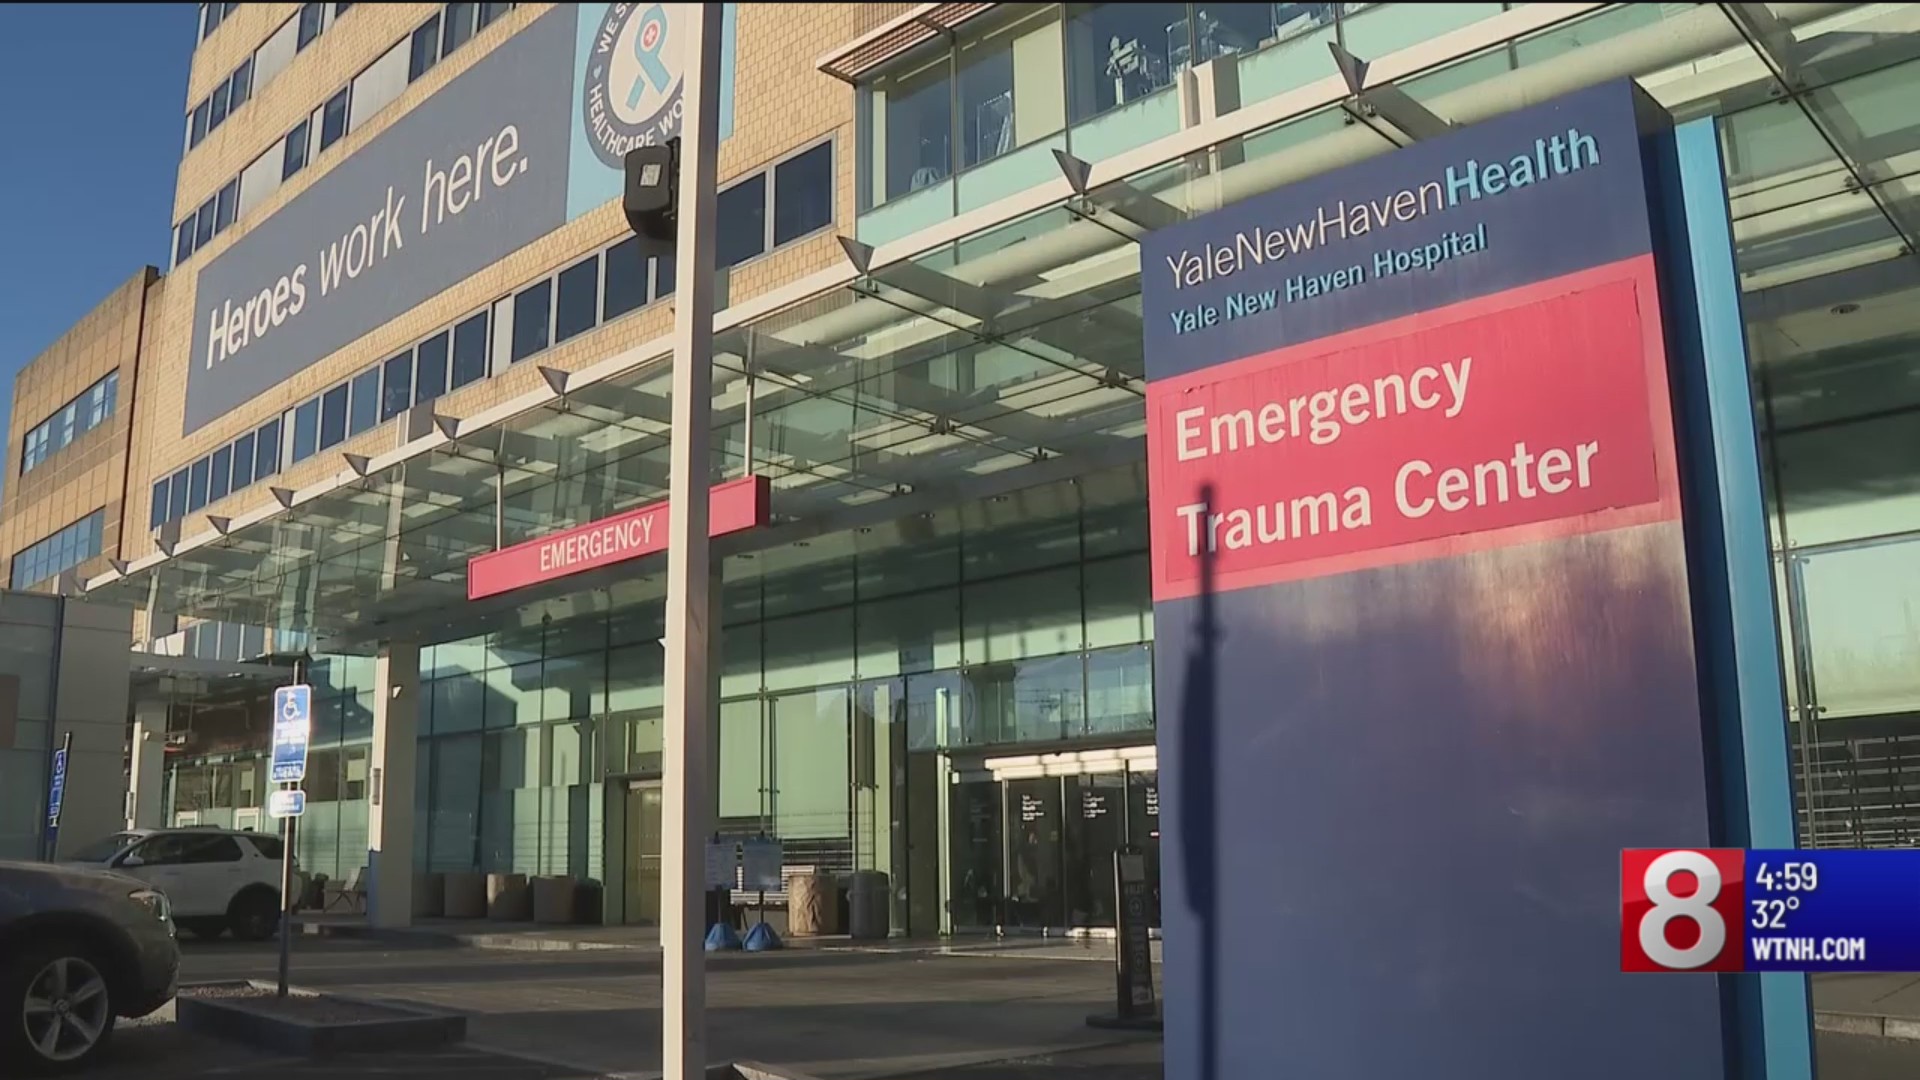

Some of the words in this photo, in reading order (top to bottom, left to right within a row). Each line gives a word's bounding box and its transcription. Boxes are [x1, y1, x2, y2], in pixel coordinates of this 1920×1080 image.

[590, 82, 657, 157] HEALTHCARE
[658, 96, 684, 136] WO
[206, 264, 307, 370] Heroes
[320, 186, 405, 297] work
[421, 125, 528, 234] here.
[1171, 305, 1218, 335] Yale
[1225, 287, 1277, 320] New
[1286, 260, 1364, 303] Haven
[1373, 224, 1488, 280] Hospital
[1175, 357, 1472, 462] Emergency
[540, 514, 655, 572] EMERGENCY
[1176, 485, 1373, 557] Trauma
[1394, 440, 1599, 519] Center
